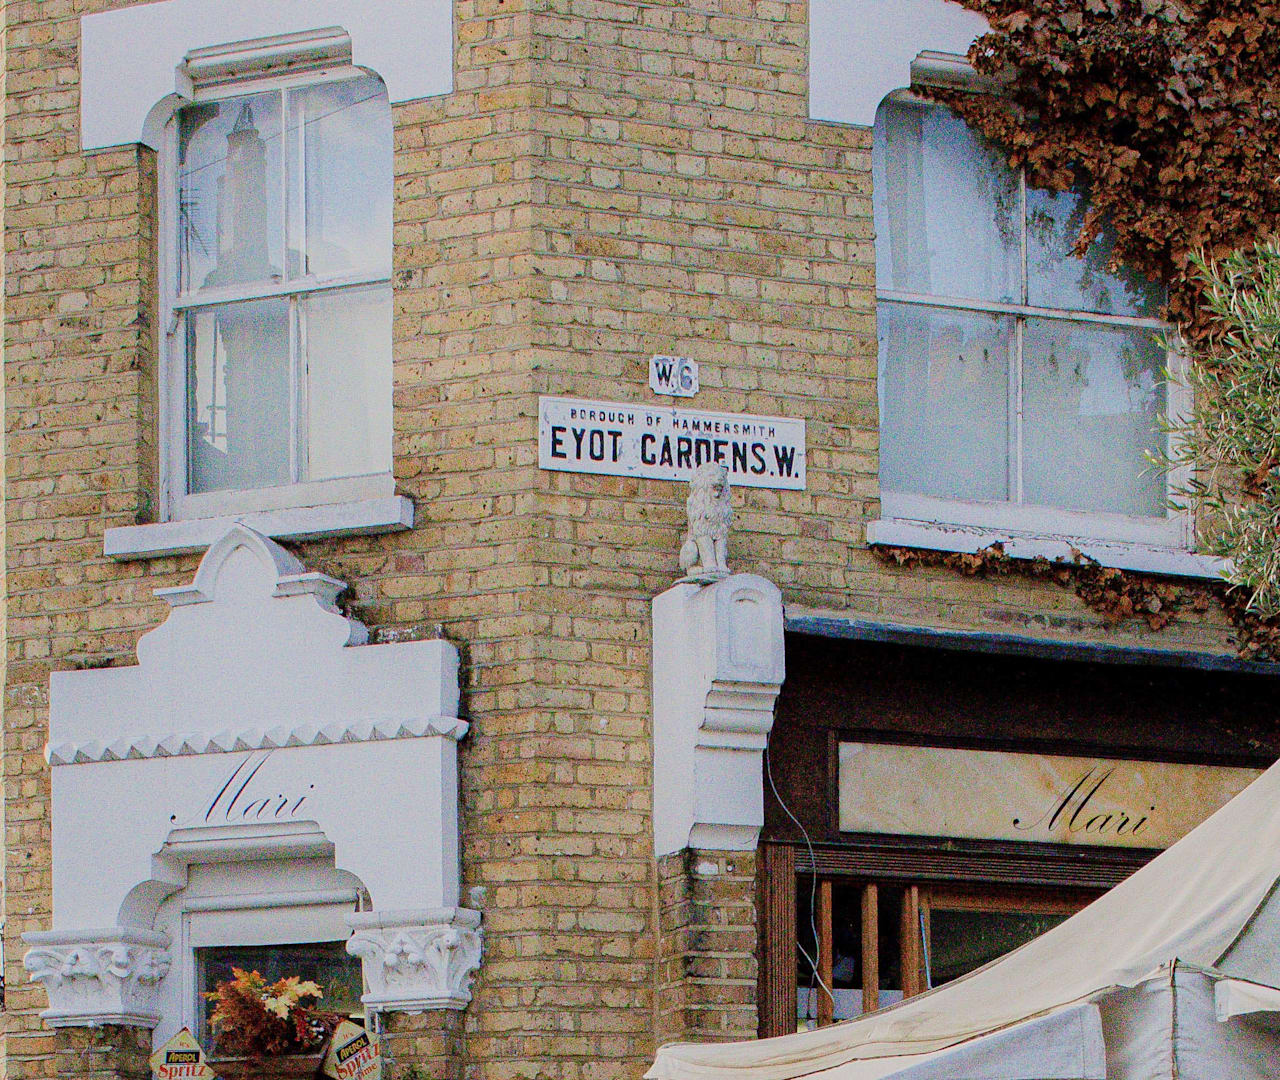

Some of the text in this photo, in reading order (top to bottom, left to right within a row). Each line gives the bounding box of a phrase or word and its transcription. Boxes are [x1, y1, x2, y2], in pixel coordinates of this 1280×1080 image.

[570, 408, 776, 438] BOROUGH OF HAMMERSMITH
[550, 425, 622, 463] EYOT
[170, 749, 315, 824] Mari
[1012, 766, 1157, 837] Mari
[168, 1052, 197, 1062] APEROL
[340, 1038, 367, 1060] APEROL
[158, 1062, 206, 1080] Spritz
